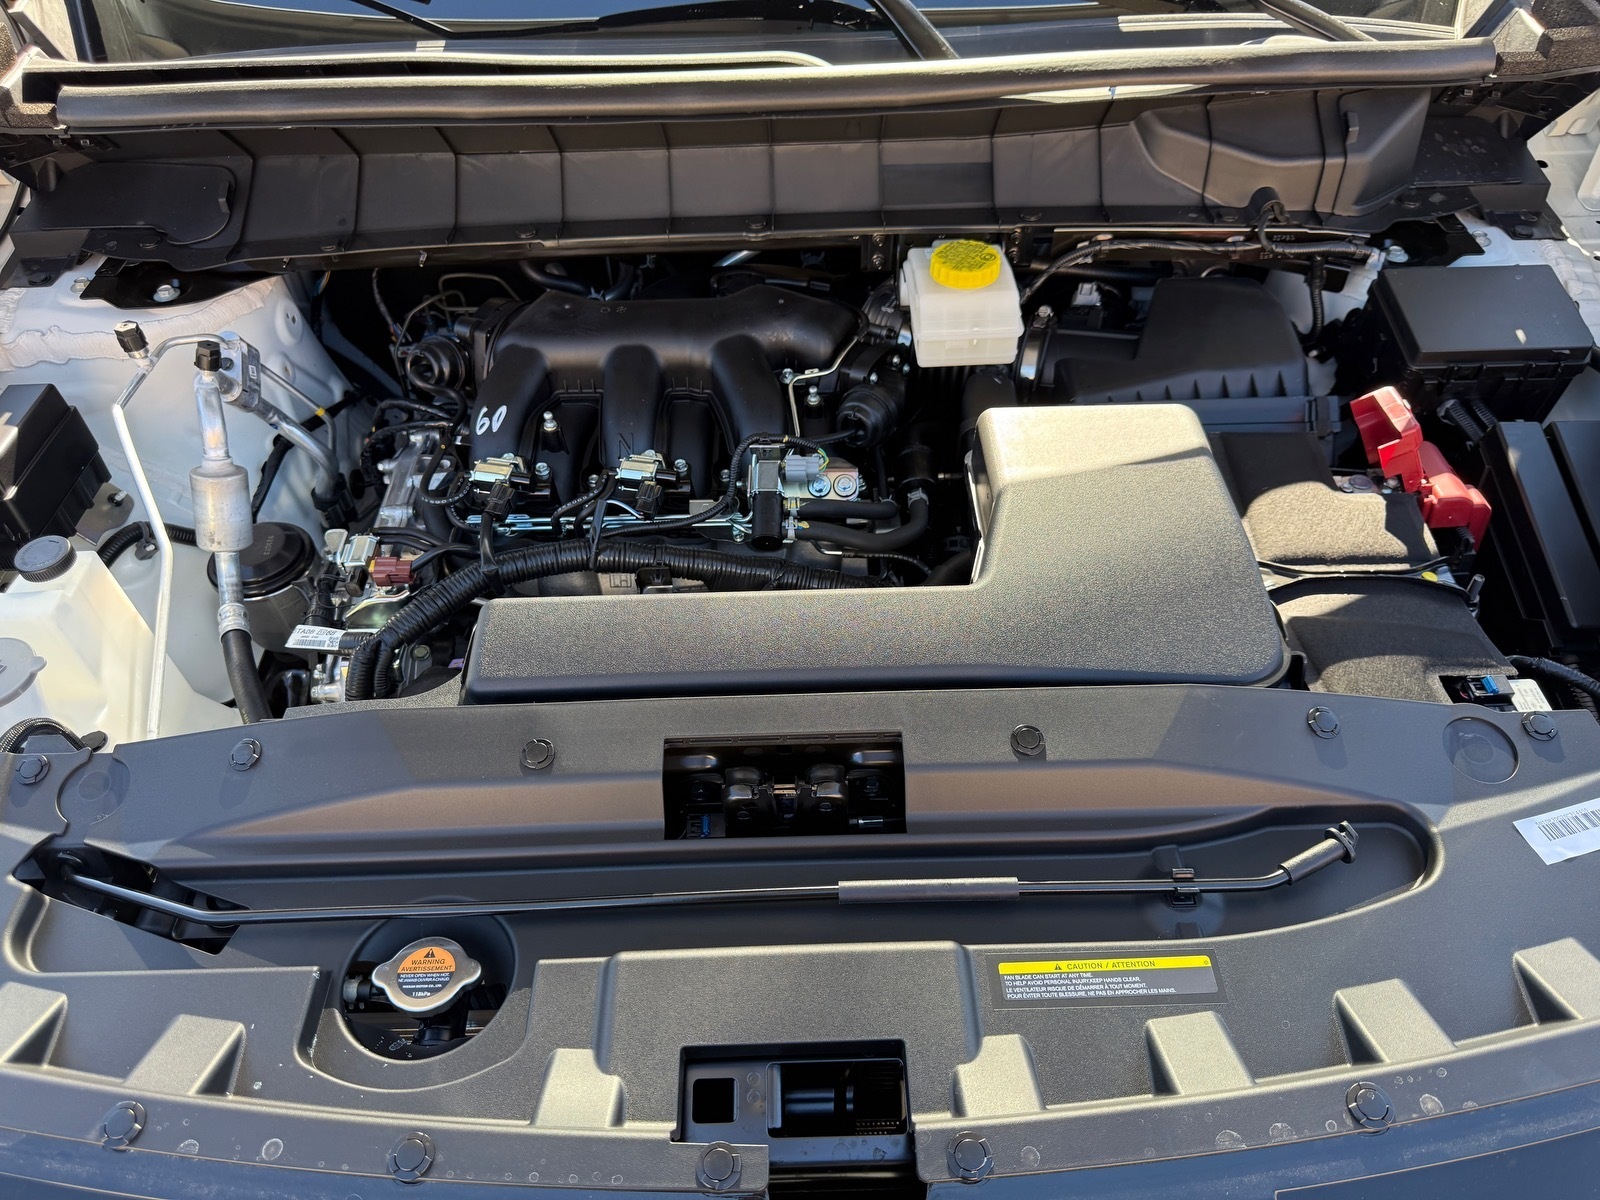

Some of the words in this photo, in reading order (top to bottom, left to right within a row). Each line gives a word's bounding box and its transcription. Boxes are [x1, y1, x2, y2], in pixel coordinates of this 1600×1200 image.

[475, 405, 508, 435] 60
[1066, 962, 1102, 970] CAUTION
[1111, 960, 1156, 968] ATTENTION
[1013, 985, 1046, 993] VENTILATEUR
[1023, 991, 1041, 999] ÉVITER
